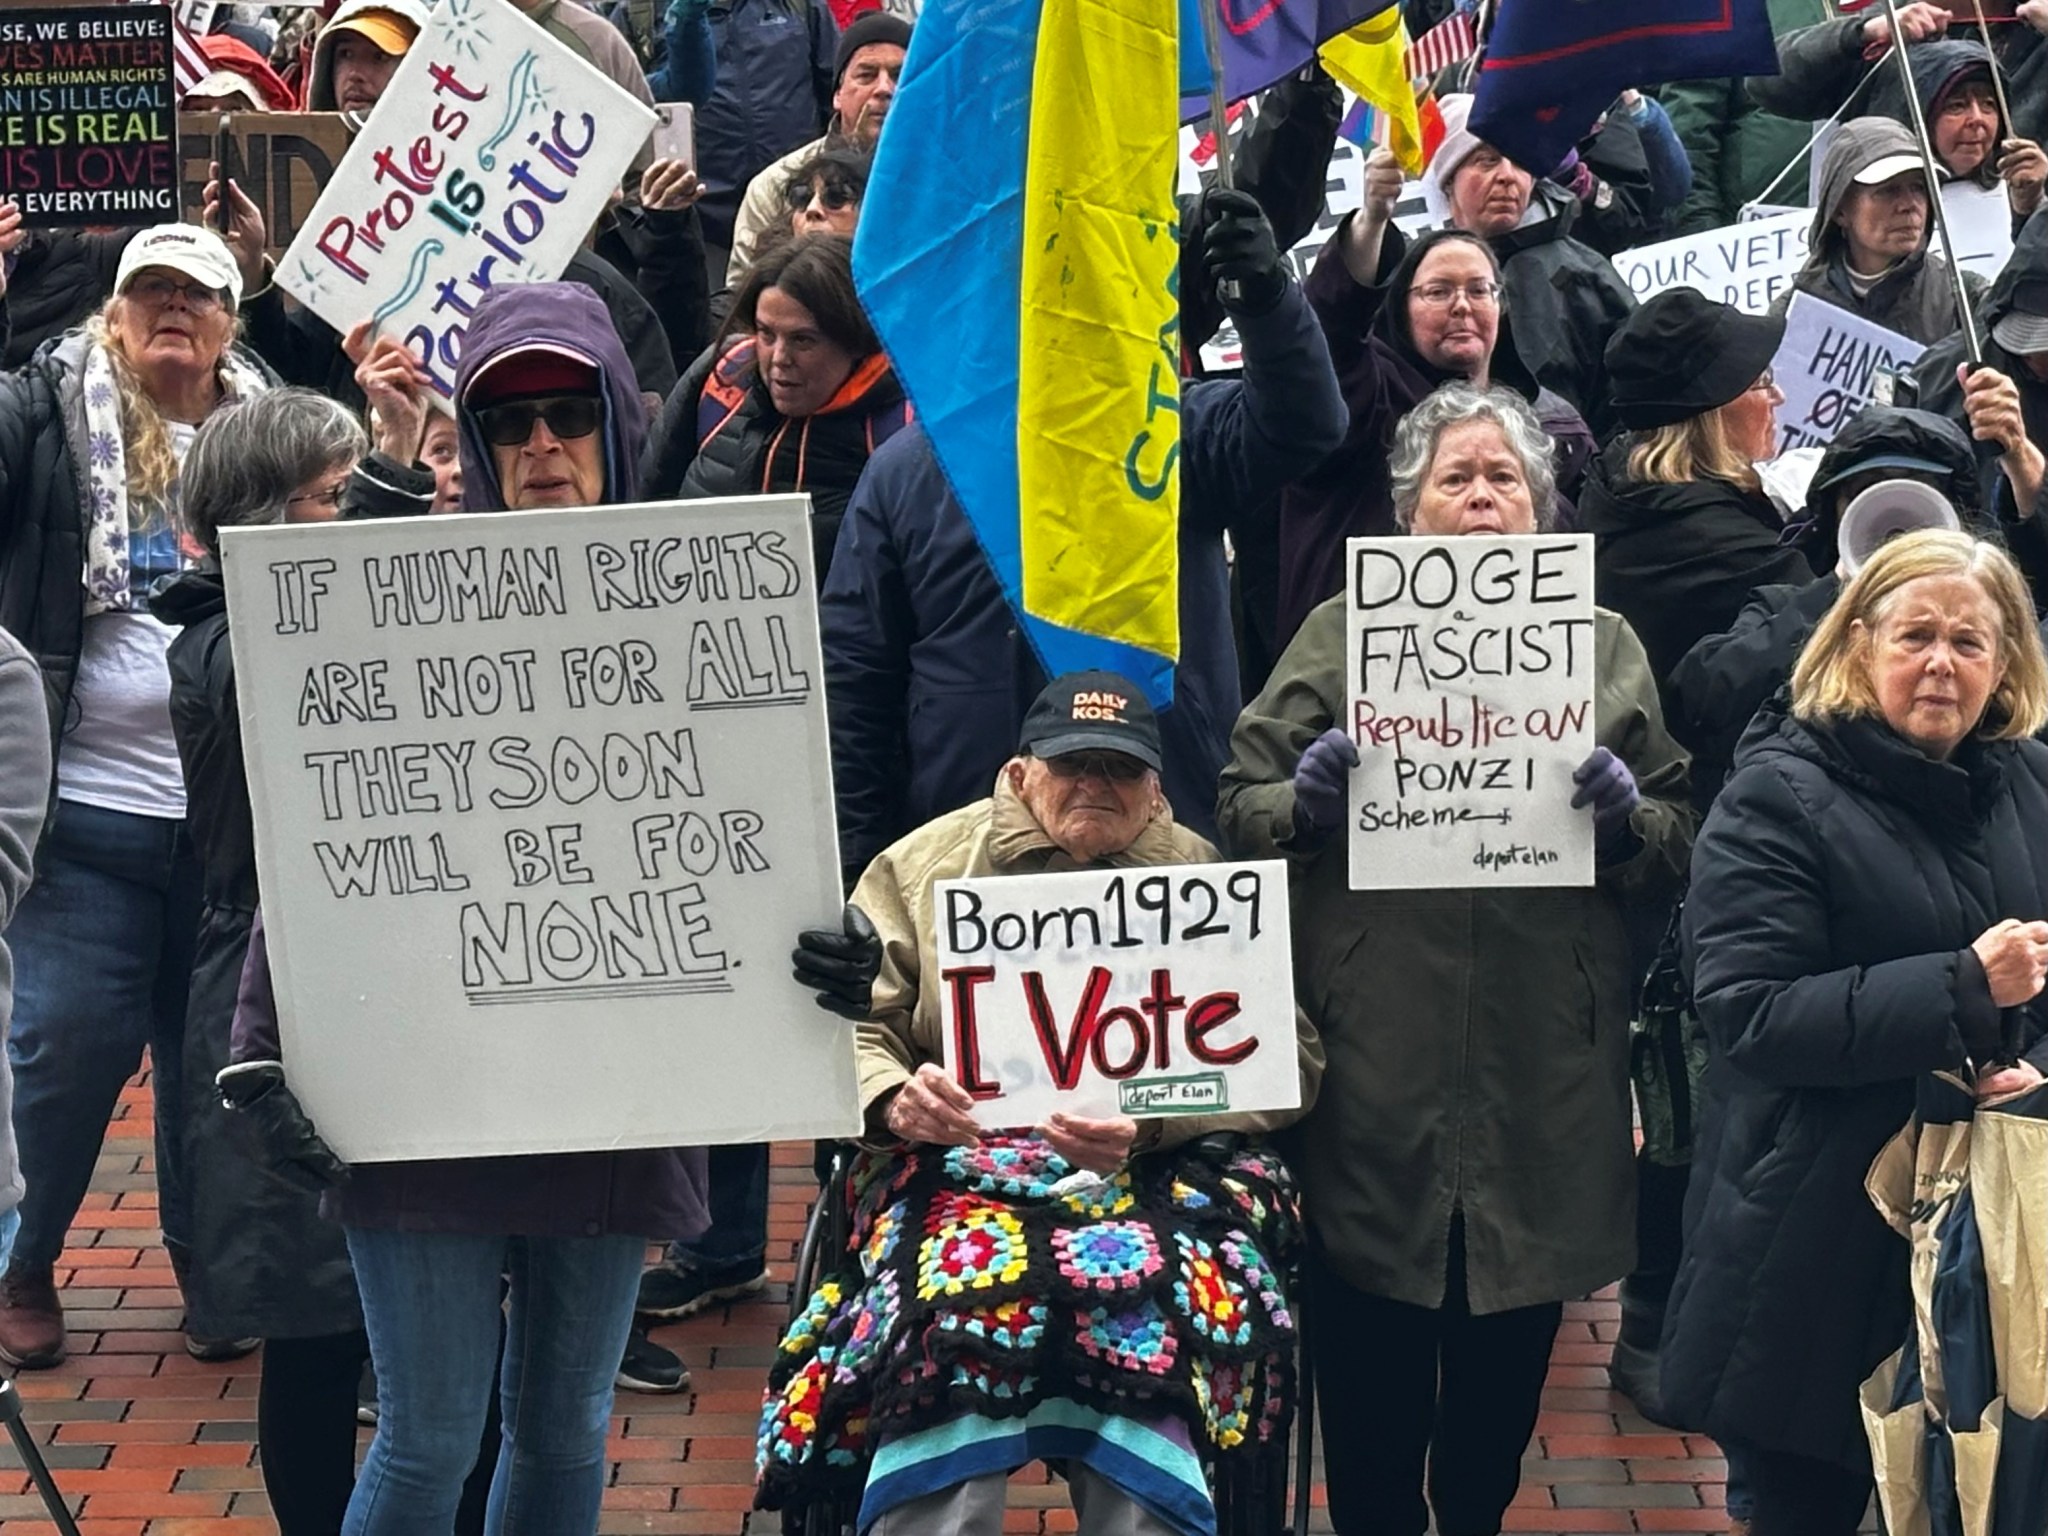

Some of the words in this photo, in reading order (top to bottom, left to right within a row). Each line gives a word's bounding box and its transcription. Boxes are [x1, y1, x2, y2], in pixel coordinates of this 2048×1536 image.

[36, 22, 68, 40] WE
[78, 19, 166, 39] BELIEVE:
[52, 40, 166, 67] MATTER
[0, 89, 22, 112] N
[30, 88, 53, 112] IS
[60, 84, 168, 111] ILLEGAL
[13, 70, 45, 86] ARE
[47, 69, 108, 85] HUMAN
[110, 68, 167, 83] RIGHTS
[35, 113, 67, 145] IS
[77, 111, 169, 144] REAL
[5, 148, 42, 190] IS
[54, 144, 171, 190] LOVE
[315, 61, 488, 285] Protest
[26, 188, 172, 213] EVERYTHING
[1628, 250, 1711, 294] OUR
[269, 558, 337, 635] IF
[363, 546, 567, 629] HUMAN
[586, 530, 801, 612] RIGHTS
[1355, 544, 1579, 611] DOGE
[1453, 610, 1476, 622] a
[297, 659, 397, 726] ARE
[417, 649, 536, 719] NOT
[561, 640, 664, 709] FOR
[685, 614, 811, 703] ALL
[1360, 618, 1594, 694] FASCIST
[1072, 706, 1116, 722] KOS
[1073, 691, 1129, 711] DAILY
[304, 740, 475, 821] THEY
[488, 728, 704, 810] SOON
[1394, 756, 1534, 798] PONZI
[312, 832, 470, 898] WILL
[504, 822, 594, 888] BE
[632, 810, 771, 881] FOR
[944, 888, 1101, 955] Born
[1103, 869, 1262, 949] 1929
[459, 883, 742, 987] NONE.
[941, 964, 1008, 1103] I
[1020, 964, 1260, 1092] Vote
